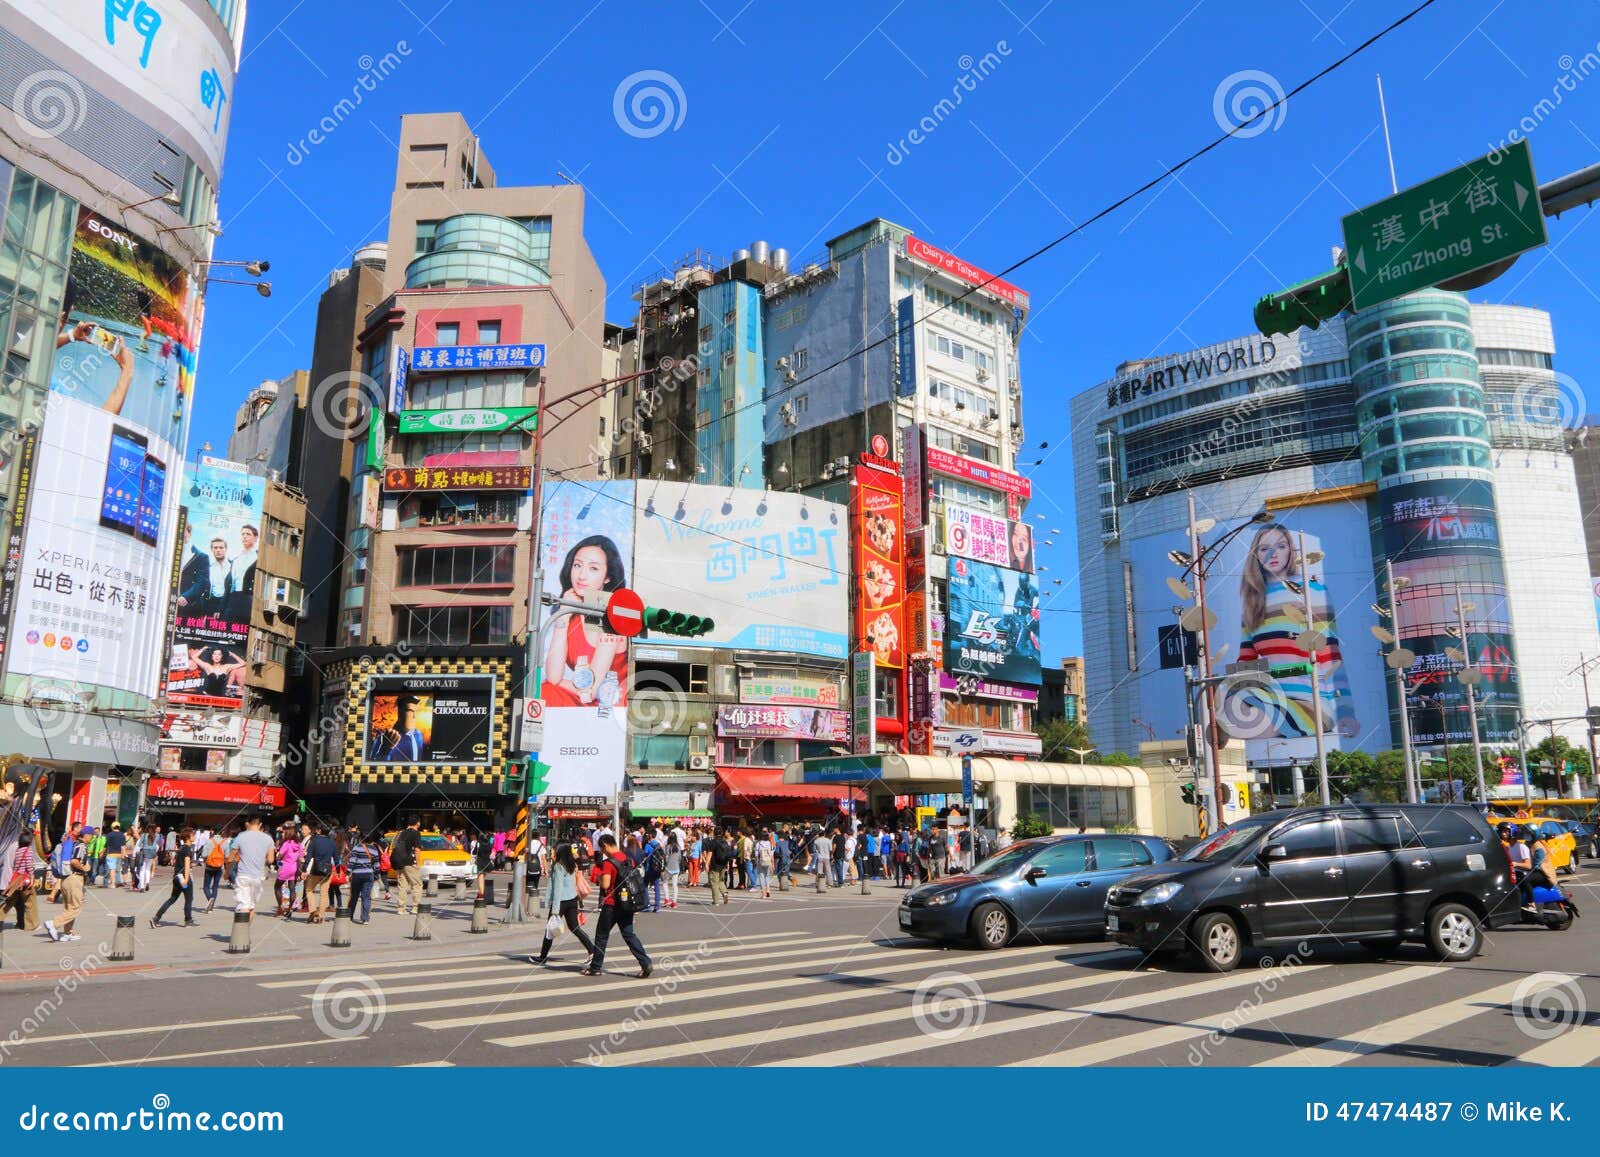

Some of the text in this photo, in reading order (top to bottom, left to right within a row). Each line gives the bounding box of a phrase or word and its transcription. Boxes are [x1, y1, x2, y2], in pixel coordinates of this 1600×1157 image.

[1372, 175, 1499, 252] 漢中街
[87, 219, 137, 249] SONY
[922, 244, 943, 265] Diary
[1378, 224, 1509, 284] HanZhong St.
[477, 347, 528, 361] 補習班
[970, 466, 989, 480] HOTEL
[947, 506, 970, 524] 11/29
[953, 527, 965, 551] 9
[37, 548, 101, 576] XPERIA
[705, 526, 839, 586] 西門町
[433, 706, 487, 715] CHOCOOLATE
[192, 734, 237, 743] hair salon
[559, 746, 600, 756] SEIKO
[1237, 790, 1246, 809] 6
